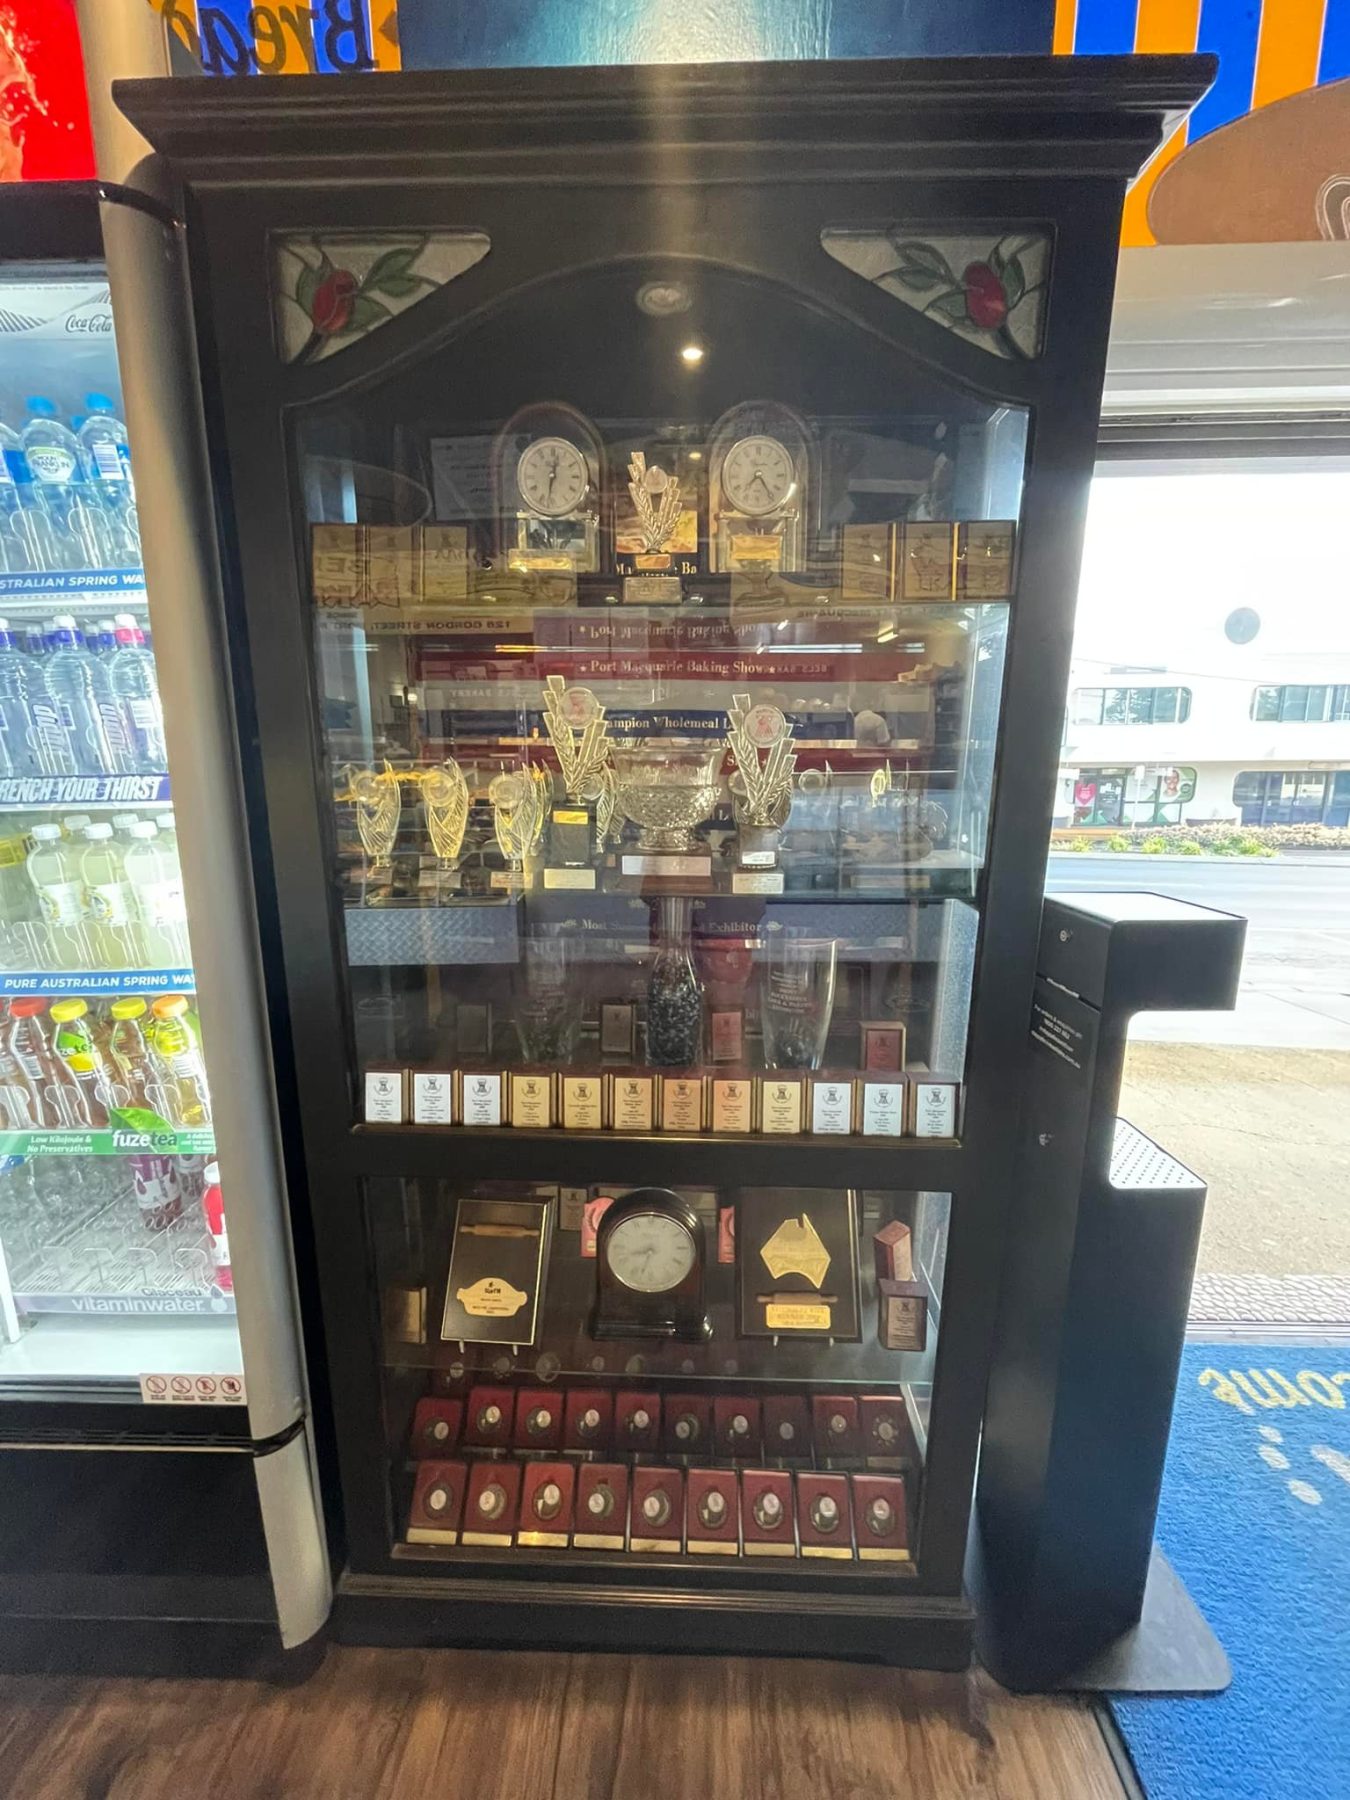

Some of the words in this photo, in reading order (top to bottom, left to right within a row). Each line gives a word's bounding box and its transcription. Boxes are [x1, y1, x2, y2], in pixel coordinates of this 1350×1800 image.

[68, 575, 118, 587] SPRING
[122, 573, 145, 585] WA
[591, 660, 618, 673] Port
[687, 660, 729, 675] Baking
[732, 660, 763, 674] Show
[604, 715, 651, 732] ampion
[652, 712, 719, 731] Wholemeal
[54, 776, 99, 800] YOUR
[103, 775, 164, 799] THIRST
[708, 922, 762, 933] Exhibitor
[4, 978, 38, 989] PURE
[40, 977, 120, 989] AUSTRALIAN
[123, 975, 169, 987] SPRING
[112, 1130, 177, 1147] fuzetea
